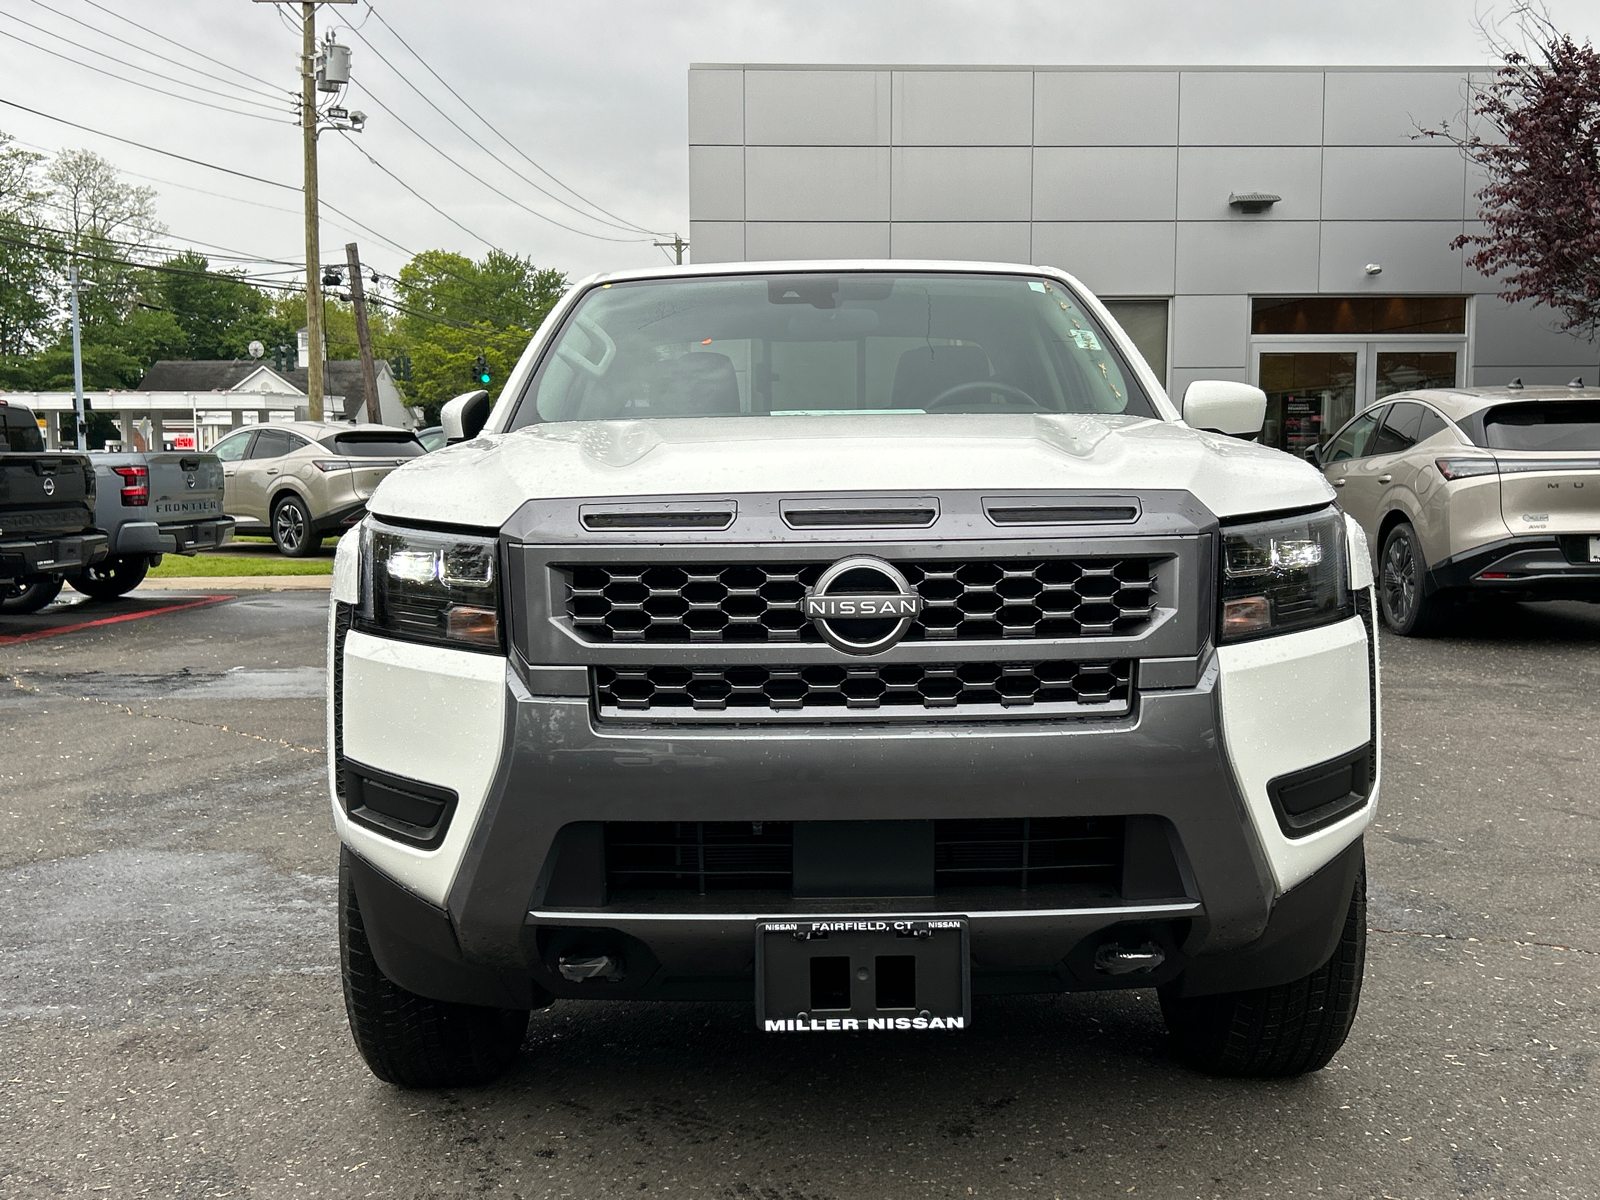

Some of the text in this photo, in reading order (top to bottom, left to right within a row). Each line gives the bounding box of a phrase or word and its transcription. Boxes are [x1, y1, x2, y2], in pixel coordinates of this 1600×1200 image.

[156, 501, 216, 513] FRONTIER
[809, 600, 916, 614] NISSAN
[812, 922, 890, 931] FAIRFIELD,
[894, 921, 914, 930] CT
[928, 921, 961, 929] NISSAN
[764, 1017, 964, 1031] MILLER NISSAN
